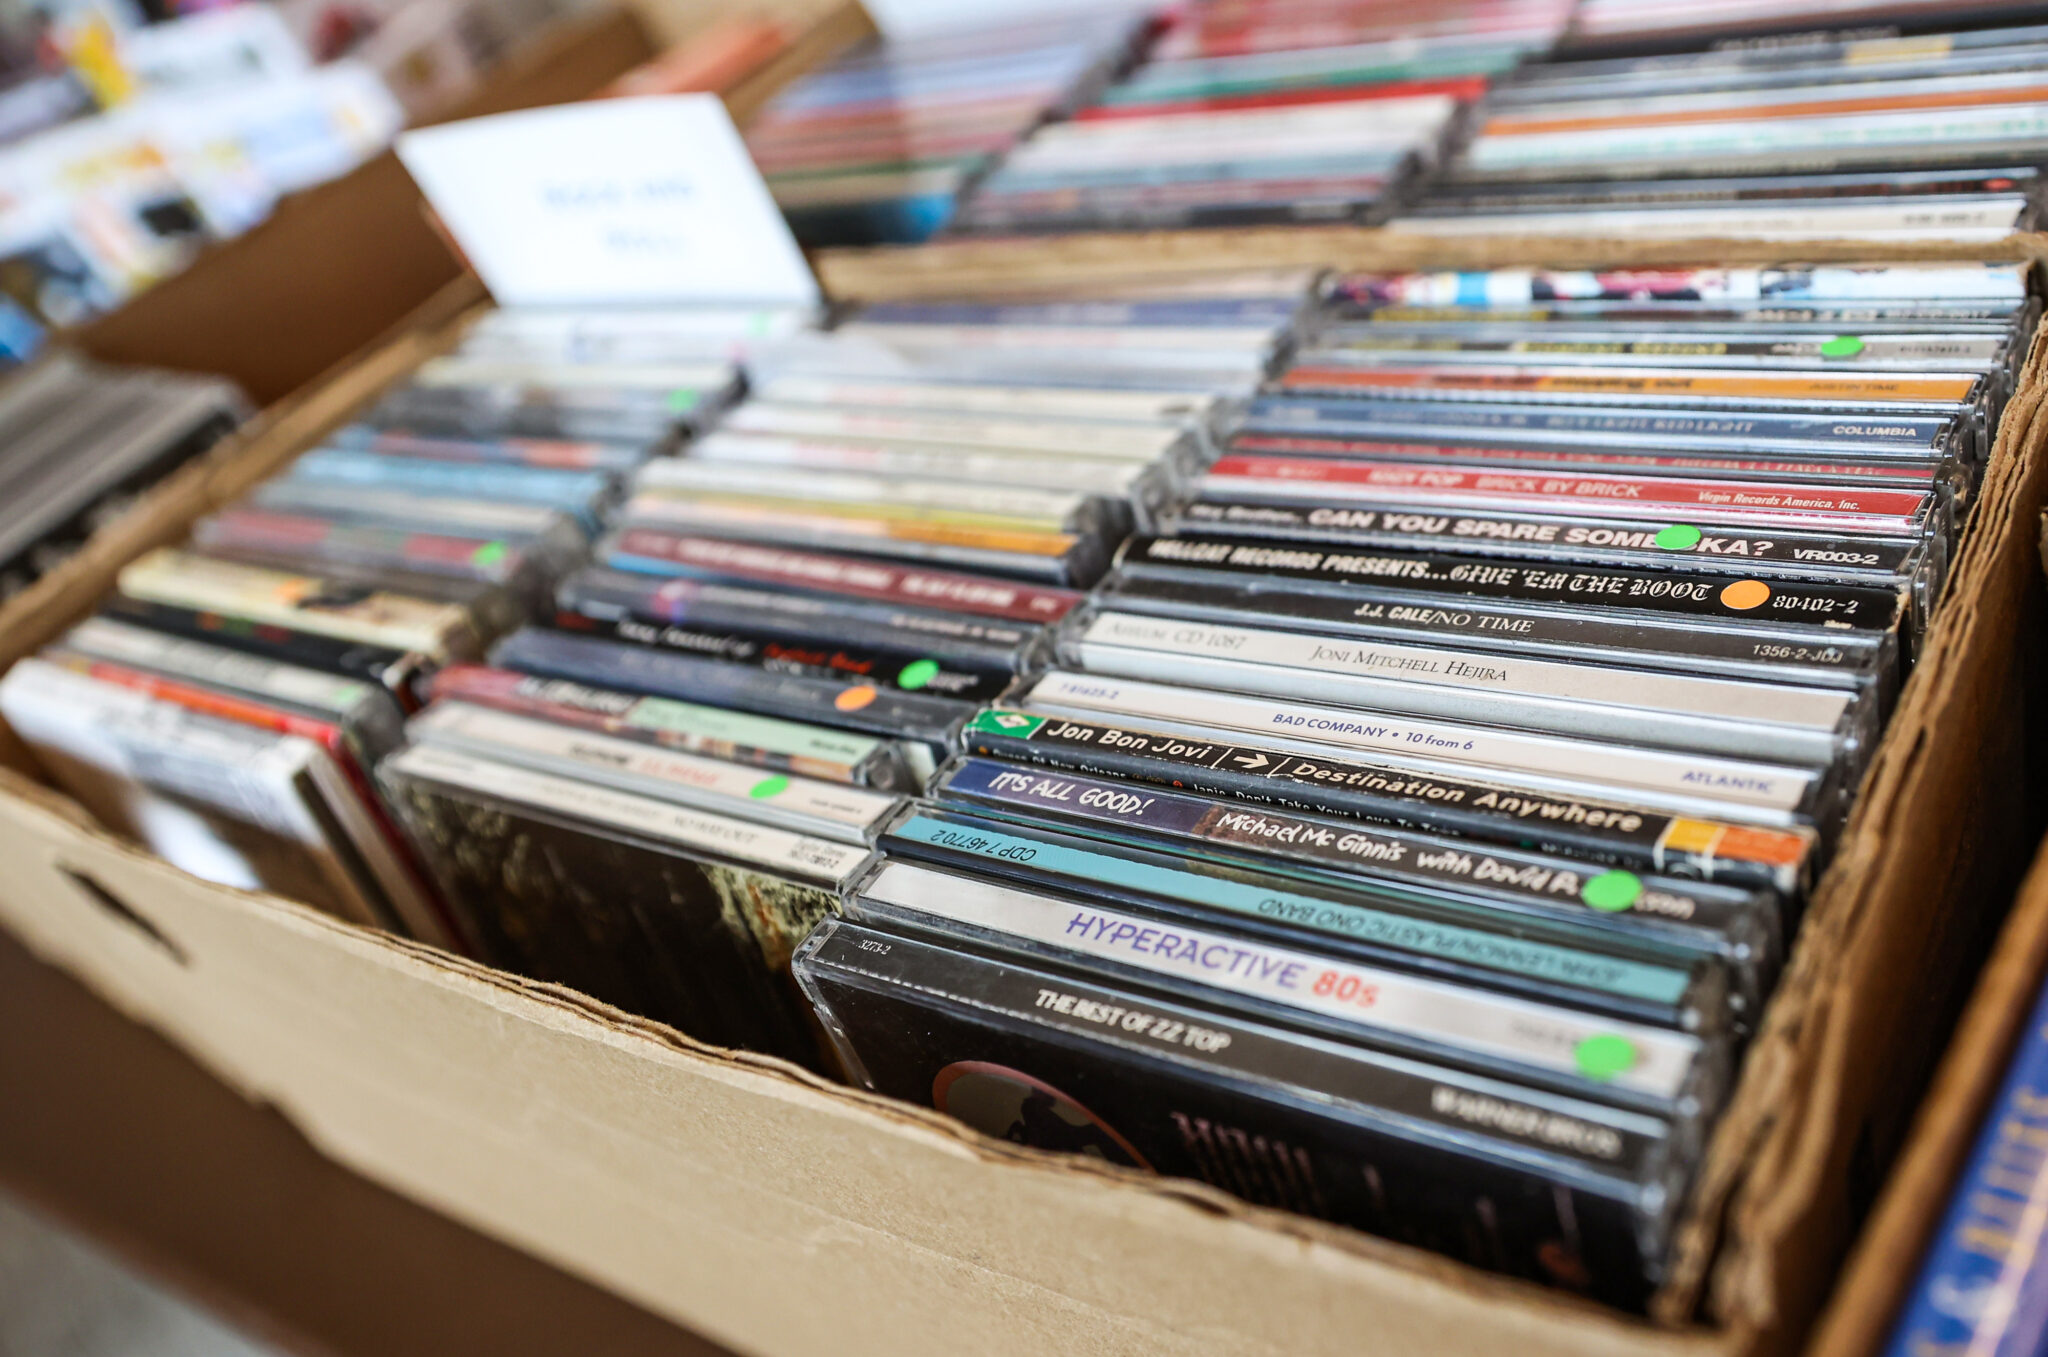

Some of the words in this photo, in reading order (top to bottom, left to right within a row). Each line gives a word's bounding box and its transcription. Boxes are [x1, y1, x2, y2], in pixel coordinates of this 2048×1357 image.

[1832, 425, 1917, 437] COLUMBIA
[1419, 472, 1465, 488] POP
[1475, 475, 1538, 492] BRICK
[1542, 478, 1575, 494] BY
[1575, 479, 1644, 499] BRICK
[1698, 491, 1731, 503] Virgin
[1733, 493, 1780, 506] Records
[1838, 500, 1860, 511] Inc.
[1308, 508, 1376, 528] CAN
[1382, 513, 1450, 533] YOU
[1452, 518, 1560, 541] SPARE
[1680, 534, 1774, 556] KA?
[1793, 548, 1879, 564] VR003-2
[1229, 546, 1323, 570] RECORDS
[1568, 572, 1628, 594] THE
[1772, 594, 1860, 614] 80402-2
[1354, 603, 1383, 618] J.J.
[1478, 615, 1536, 633] TIME
[1173, 628, 1204, 645] CD
[1206, 631, 1248, 650] 1087
[1308, 644, 1350, 663] JONI
[1353, 650, 1439, 674] MITCHELL
[1443, 660, 1508, 681] HEJIRA
[1272, 713, 1306, 727] BAD
[1306, 718, 1389, 738] COMPANY
[1047, 722, 1097, 742] Jon
[1098, 729, 1149, 751] Bon
[1151, 738, 1212, 760] Jovi
[1404, 731, 1424, 744] 10
[1424, 733, 1461, 749] from
[1462, 740, 1474, 751] 6
[989, 771, 1029, 793] IT'S
[1032, 778, 1074, 801] ALL
[1079, 787, 1156, 815] GOOD!
[1681, 770, 1776, 794] ATLANTIC
[1291, 761, 1466, 802] Destination
[1473, 790, 1644, 832] Anywhere
[999, 847, 1038, 863] CDP
[1215, 812, 1303, 845] Michael
[1299, 826, 1335, 849] Mc
[1336, 835, 1408, 861] Ginnis
[1416, 850, 1472, 875] with
[1474, 860, 1552, 890] David
[1257, 898, 1312, 922] BAND
[859, 938, 892, 956] 3273-2
[1065, 912, 1307, 990] HYPERACTIVE
[1311, 970, 1382, 1010] 80s
[1035, 989, 1076, 1013] THE
[1071, 998, 1125, 1027] BEST
[1121, 1008, 1151, 1034] OF
[1149, 1017, 1186, 1044] ZZ
[1184, 1025, 1232, 1052] TOP
